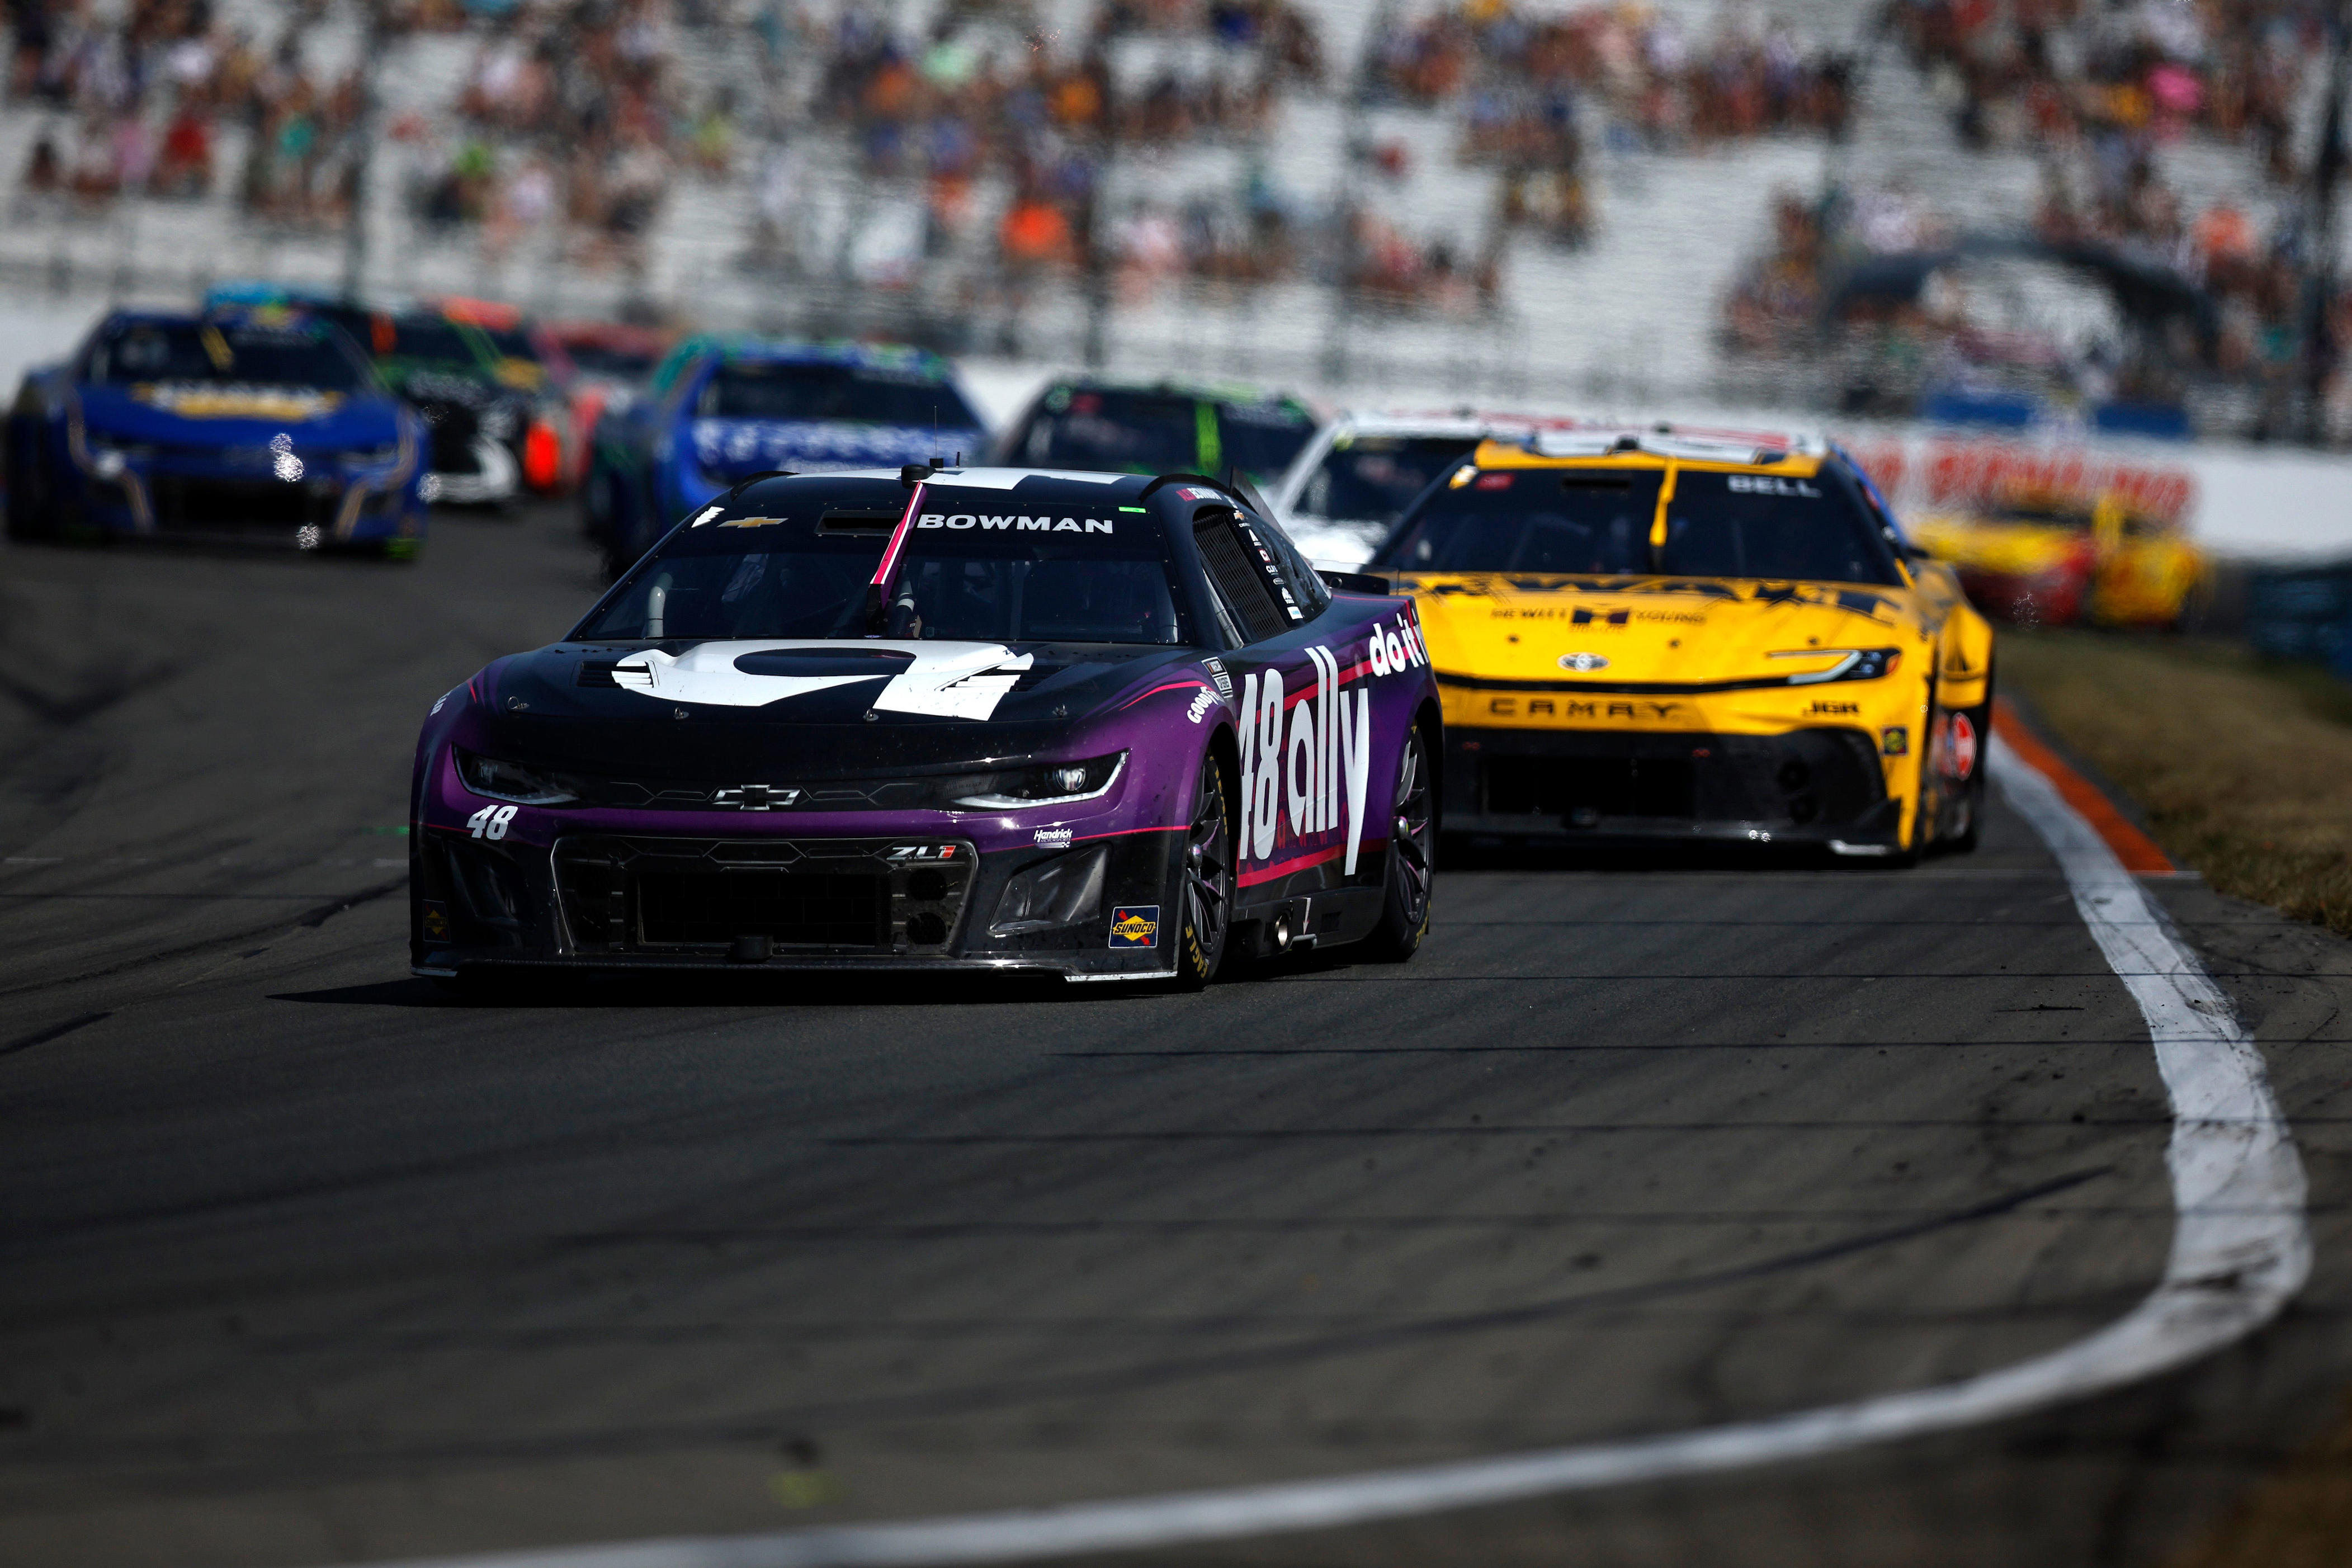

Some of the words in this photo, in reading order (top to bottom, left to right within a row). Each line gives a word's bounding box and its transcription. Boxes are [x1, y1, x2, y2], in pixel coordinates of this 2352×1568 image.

[1728, 474, 1821, 498] BELL
[917, 514, 1113, 533] BOWMAN
[1369, 622, 1406, 677] do
[1238, 668, 1284, 859] 48
[1287, 645, 1369, 875] ally
[466, 805, 518, 839] 48
[1033, 828, 1073, 843] Hendrick
[886, 845, 956, 860] ZL1
[1113, 923, 1155, 934] SUNOCO
[1186, 922, 1207, 979] EAGLE
